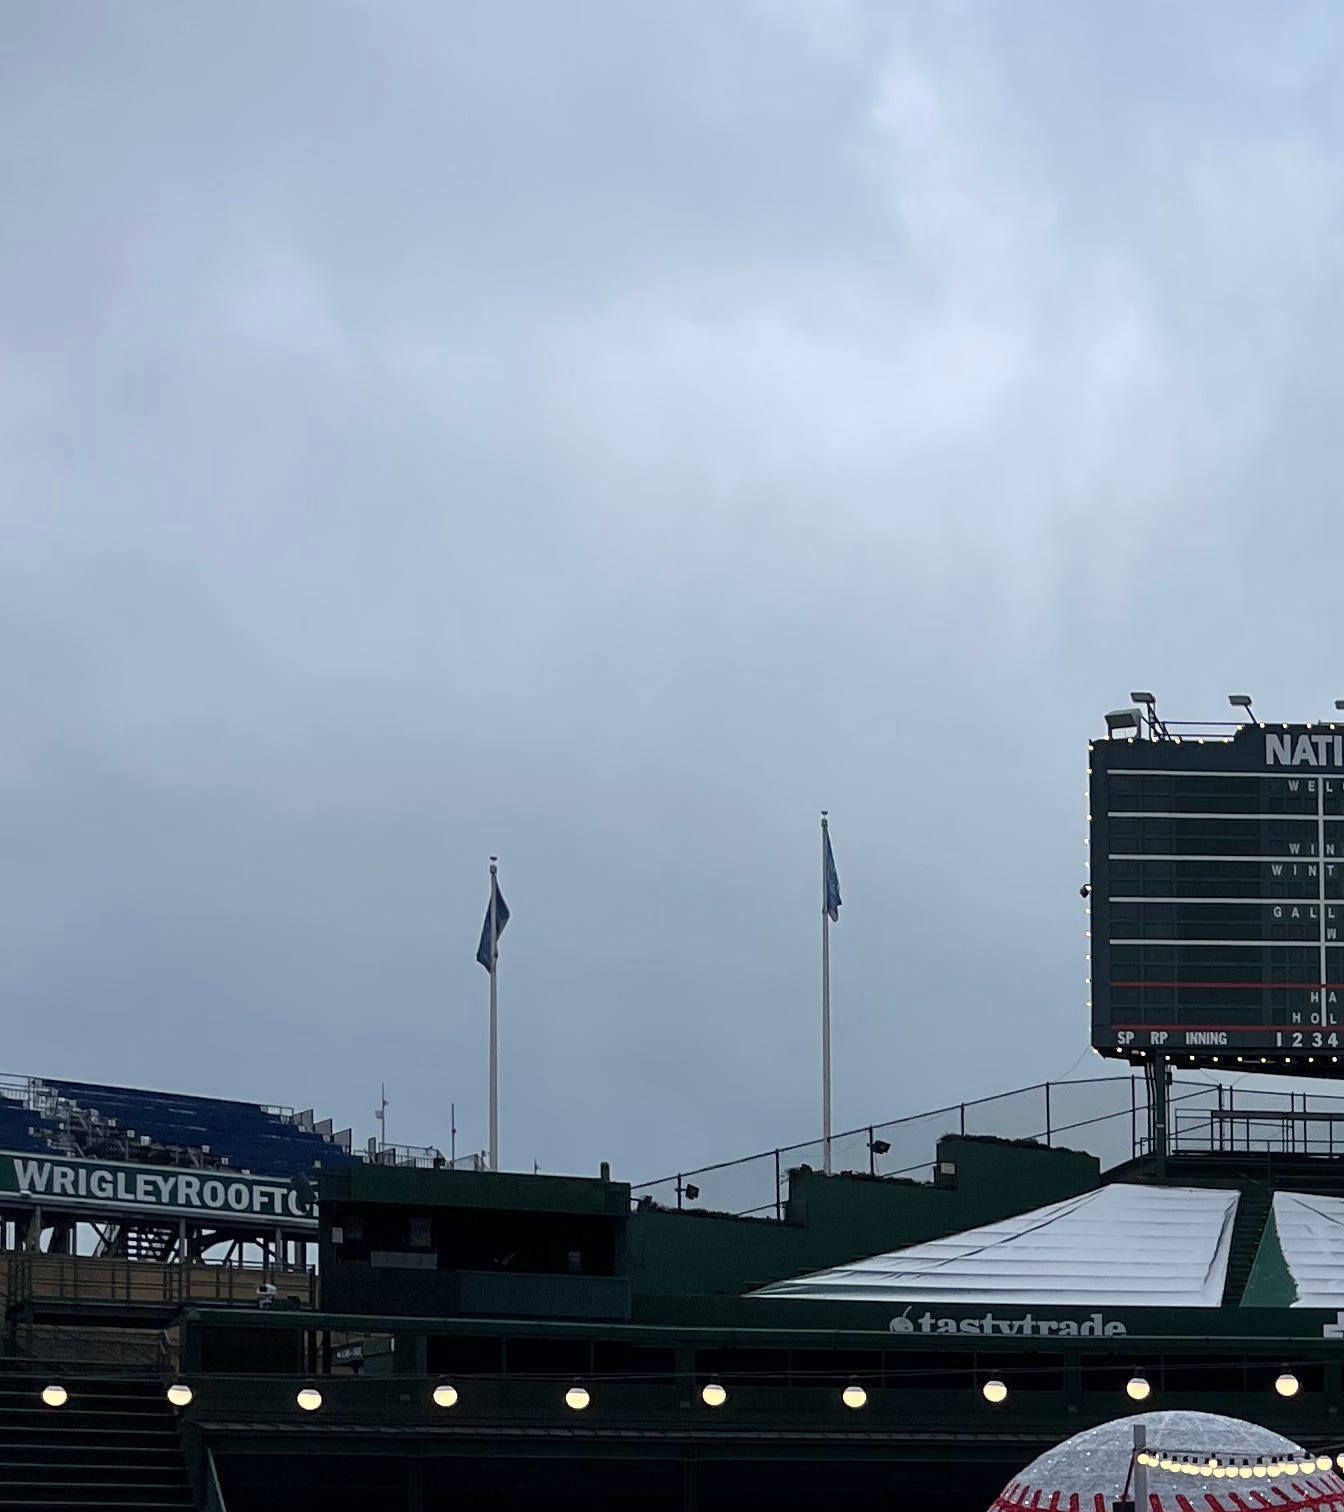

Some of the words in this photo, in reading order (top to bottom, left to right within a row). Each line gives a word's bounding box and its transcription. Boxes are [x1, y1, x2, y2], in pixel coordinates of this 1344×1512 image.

[1117, 1031, 1135, 1045] SP
[1150, 1031, 1168, 1045] RP
[1185, 1031, 1228, 1046] INNING
[1276, 1032, 1283, 1049] 1
[1292, 1032, 1303, 1049] 2
[1311, 1032, 1323, 1049] 3
[1327, 1032, 1339, 1049] 4
[12, 1158, 319, 1218] WRIGLEYROOFTO
